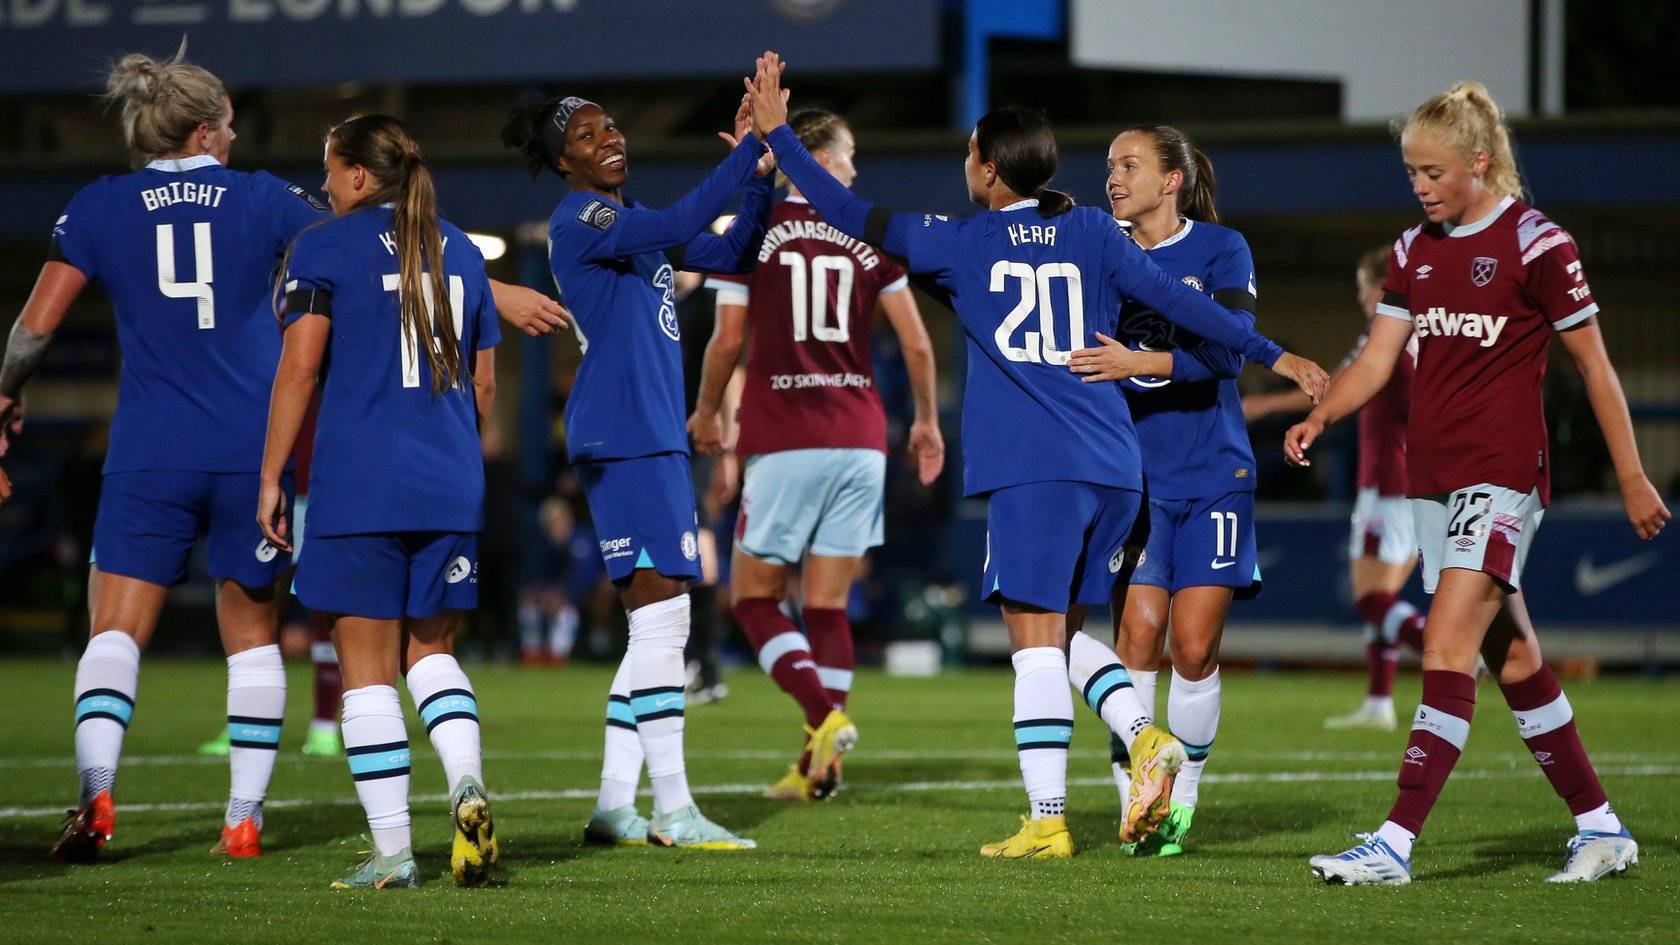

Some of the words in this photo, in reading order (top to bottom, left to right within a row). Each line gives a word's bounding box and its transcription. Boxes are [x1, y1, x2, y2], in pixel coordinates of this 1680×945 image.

[141, 181, 227, 211] BRIGHT
[1007, 223, 1056, 246] KERR
[156, 222, 215, 329] 4
[780, 251, 854, 343] 10
[989, 260, 1085, 366] 20
[1413, 307, 1508, 347] etway
[1211, 511, 1238, 557] 11
[1447, 492, 1493, 538] 22
